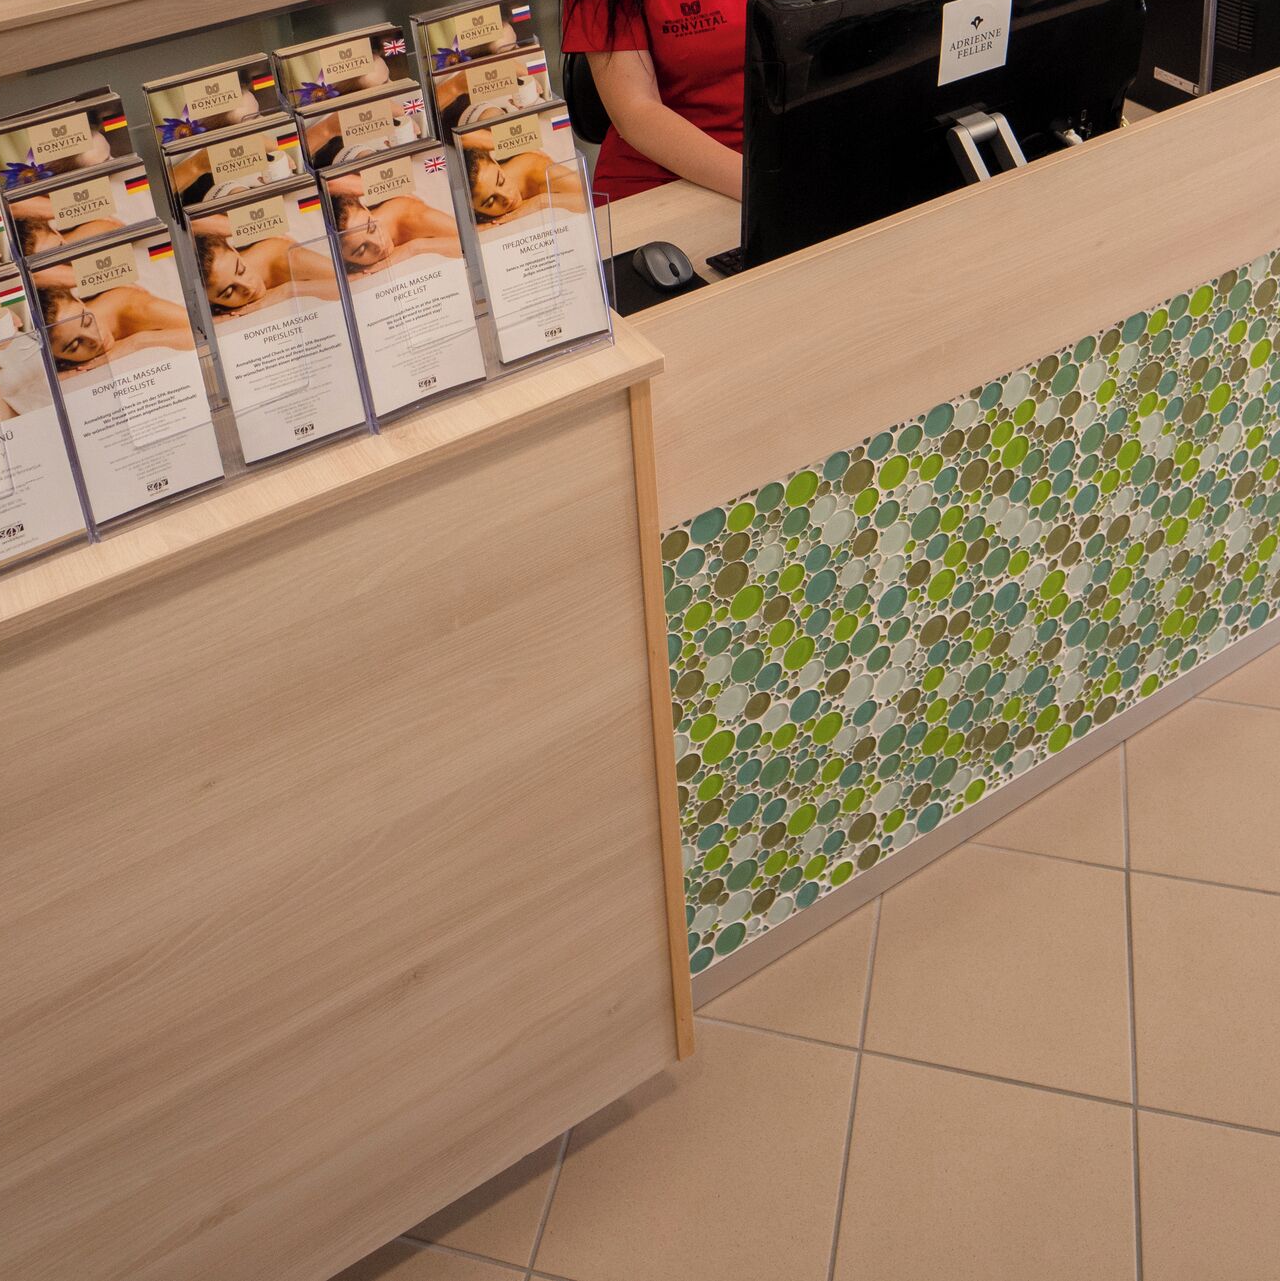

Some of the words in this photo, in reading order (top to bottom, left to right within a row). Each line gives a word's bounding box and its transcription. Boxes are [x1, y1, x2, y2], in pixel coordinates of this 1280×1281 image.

[460, 24, 500, 40] BONVITAL
[662, 15, 728, 35] BONVITAL
[949, 27, 1002, 52] ADRIENNE
[957, 40, 993, 59] FELLER
[326, 57, 371, 74] BONVITAL
[472, 79, 515, 94] BONVITAL
[191, 92, 239, 110] BONVITAL
[345, 120, 390, 137] BONVITAL
[36, 134, 88, 154] BONVITAL
[497, 133, 538, 150] BONVITAL
[215, 155, 263, 173] BONVITAL
[367, 176, 411, 195] BONVITAL
[58, 199, 110, 219] BONVITAL
[235, 217, 284, 236] BONVITAL
[520, 238, 555, 255] МАССАЖИ
[81, 265, 133, 286] BONVITAL
[375, 283, 408, 300] BONVITAL
[409, 270, 443, 286] MASSAGE
[393, 291, 412, 302] PRICE
[413, 285, 427, 296] LIST
[243, 323, 281, 341] BONVITAL
[282, 312, 320, 328] MASSAGE
[263, 327, 304, 344] PREISLISTE
[92, 376, 131, 396] BONVITAL
[133, 362, 172, 381] MASSAGE
[113, 378, 156, 399] PREISLISTE
